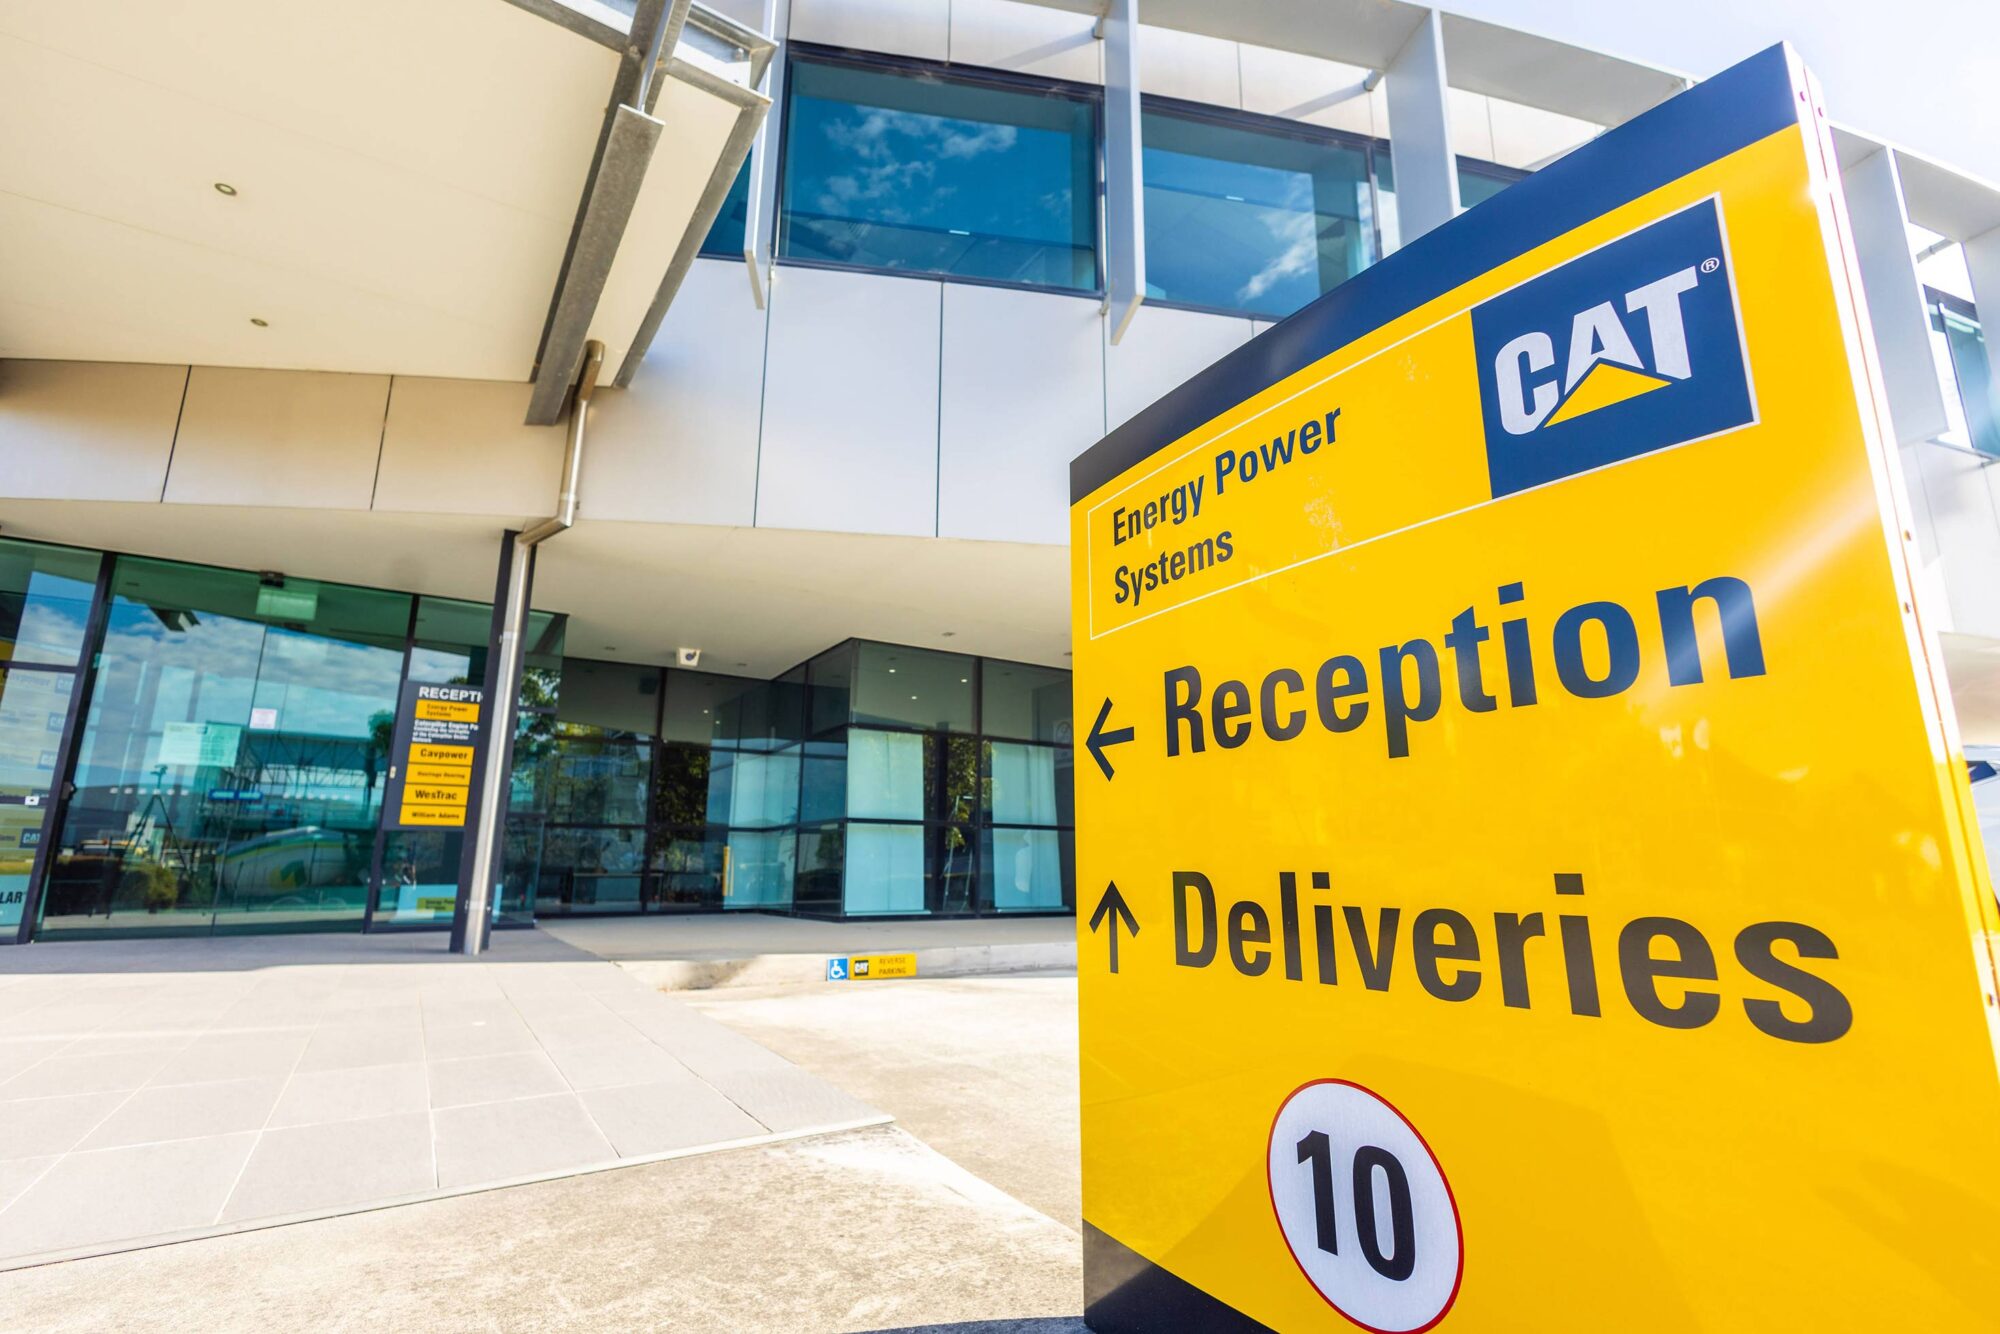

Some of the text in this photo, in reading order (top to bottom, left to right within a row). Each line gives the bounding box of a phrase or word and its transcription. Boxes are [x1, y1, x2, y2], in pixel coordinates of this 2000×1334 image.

[1494, 265, 1699, 436] CAT
[1113, 407, 1341, 547] Energy Power
[1114, 527, 1234, 607] Systems
[419, 686, 483, 703] RECEPTI
[1163, 574, 1767, 759] Reception
[415, 789, 457, 801] WesTrac
[420, 748, 468, 760] Cavpower
[1171, 870, 1854, 1045] Deliveries
[1296, 1129, 1416, 1282] 10
